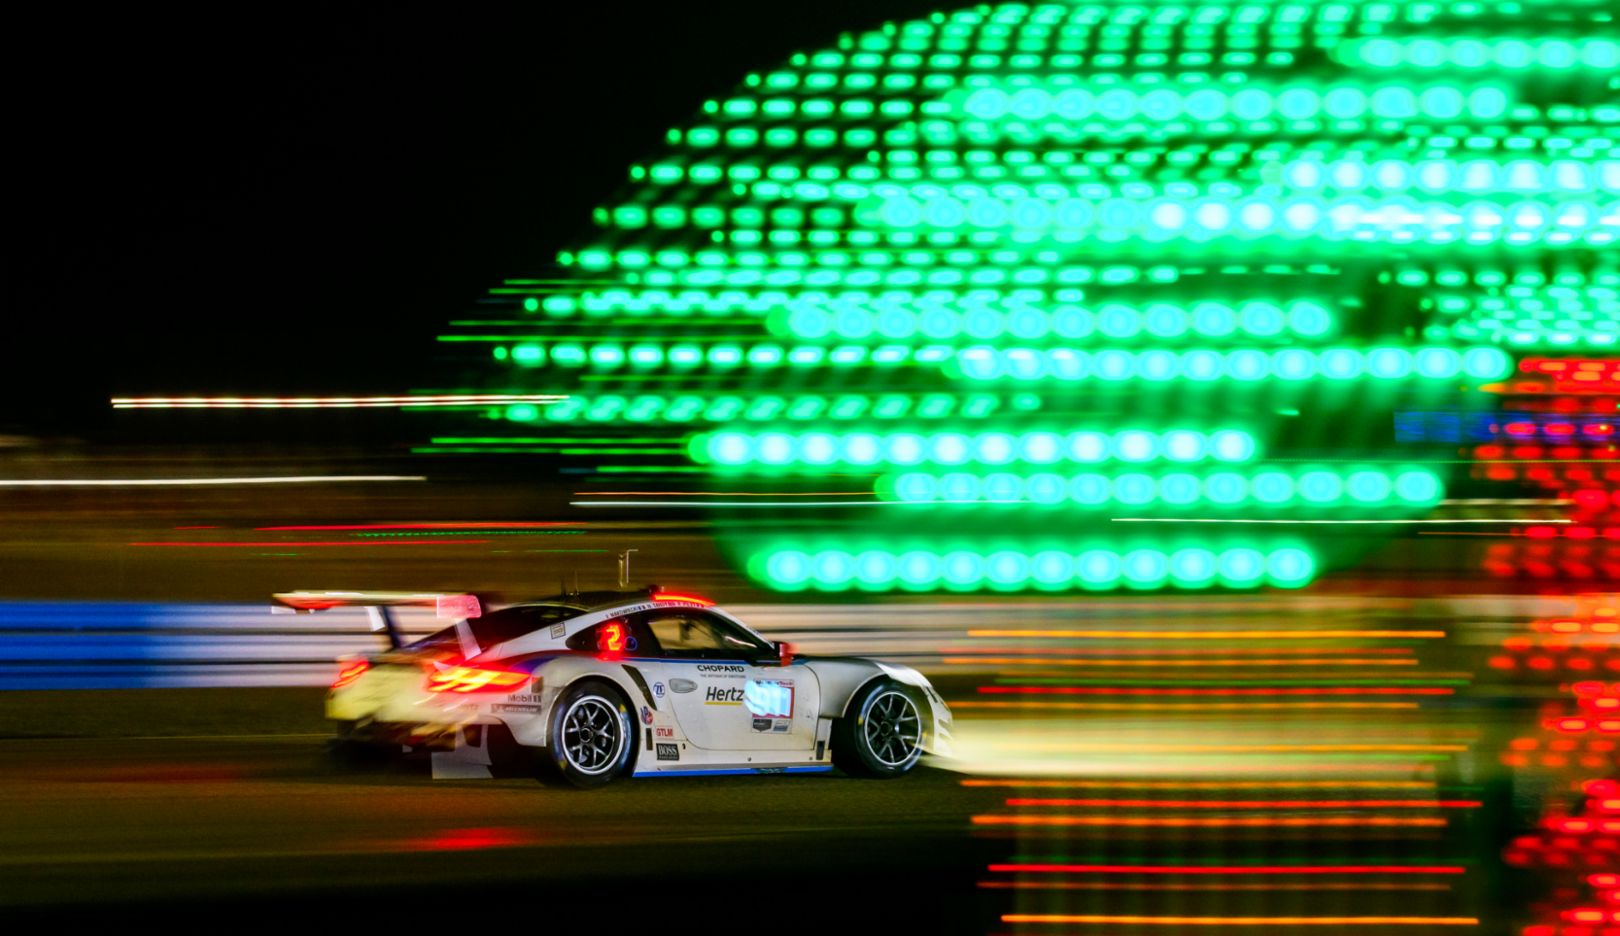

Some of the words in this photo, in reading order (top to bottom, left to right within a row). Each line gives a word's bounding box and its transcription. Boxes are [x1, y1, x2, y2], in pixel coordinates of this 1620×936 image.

[606, 624, 621, 651] 2
[697, 665, 745, 673] CHOPARD
[706, 687, 745, 701] Hertz
[656, 728, 673, 736] GTLM
[658, 745, 677, 755] BOSS
